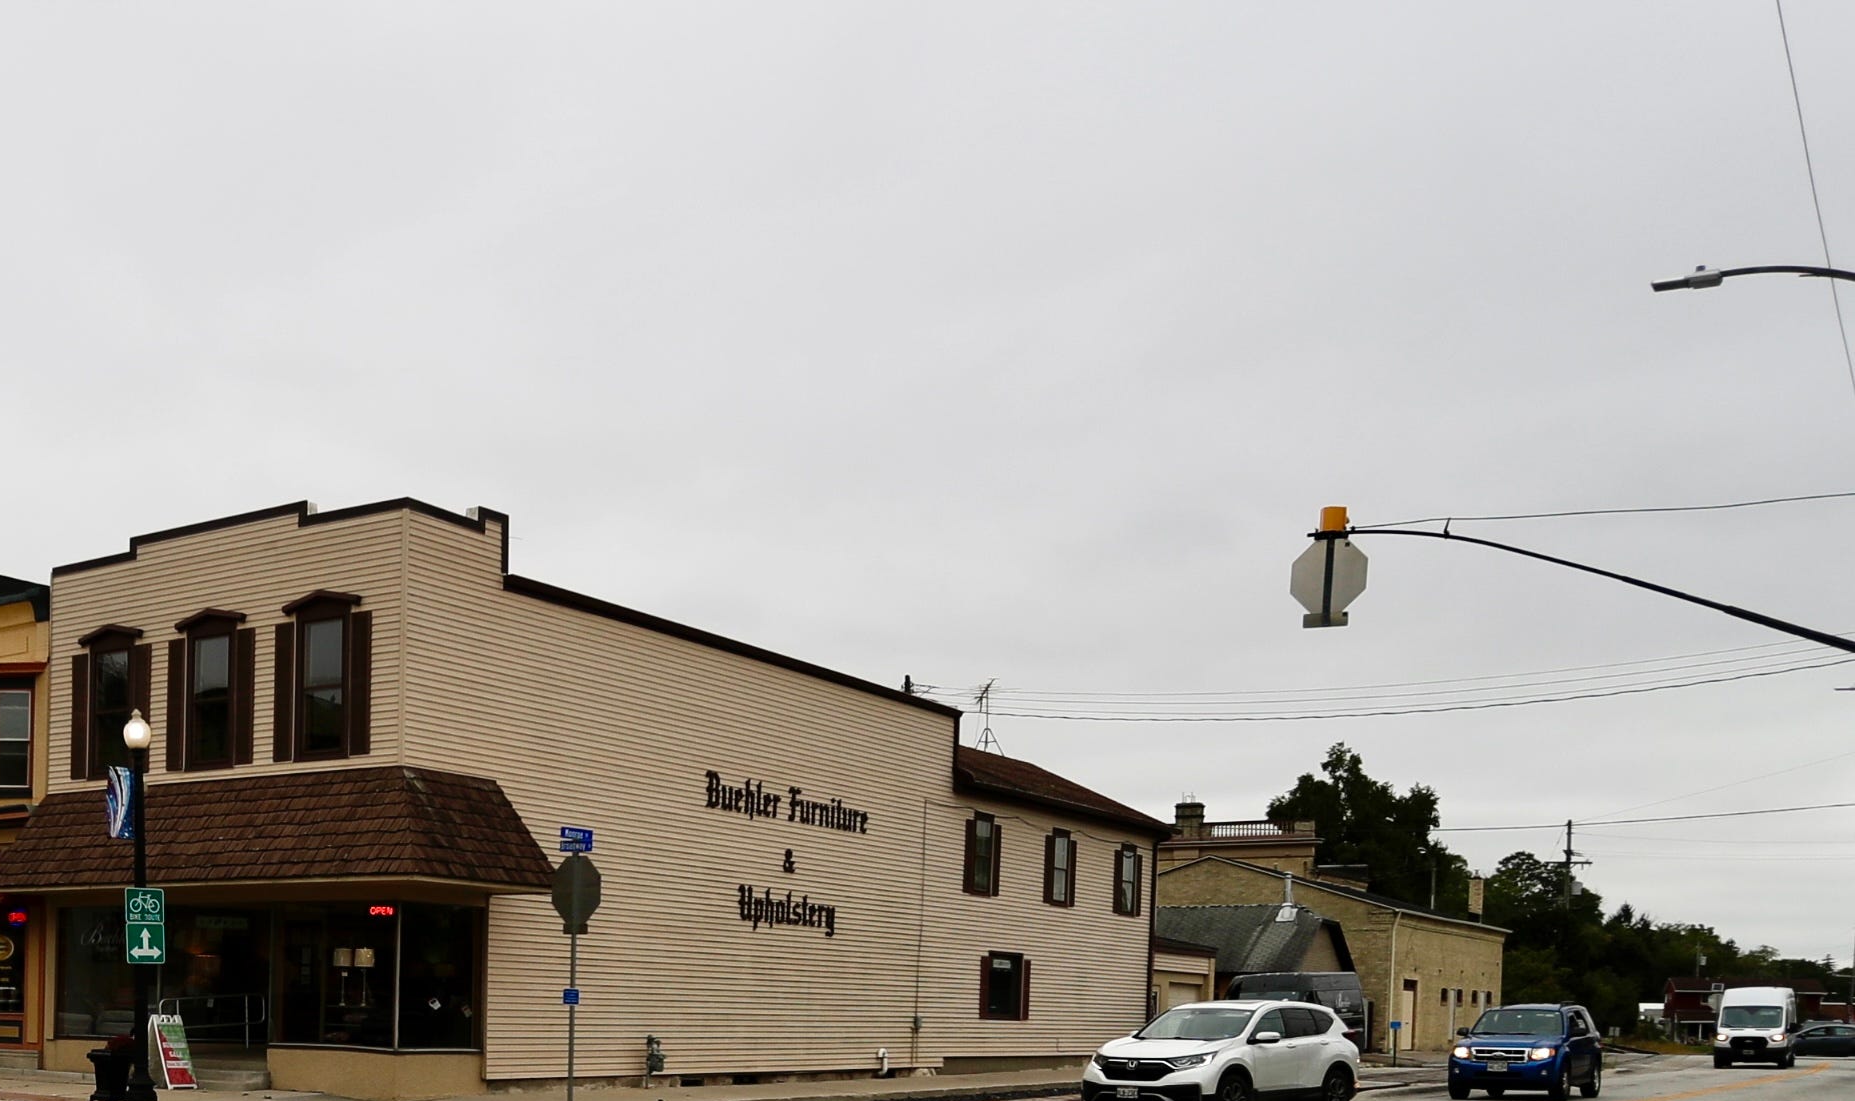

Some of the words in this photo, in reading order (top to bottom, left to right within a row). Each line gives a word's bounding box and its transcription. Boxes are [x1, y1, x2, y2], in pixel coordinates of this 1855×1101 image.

[705, 769, 782, 821] Buehler
[788, 786, 869, 835] Furniture
[782, 849, 796, 874] &
[369, 906, 393, 916] OPEN
[738, 884, 836, 938] Upholstery
